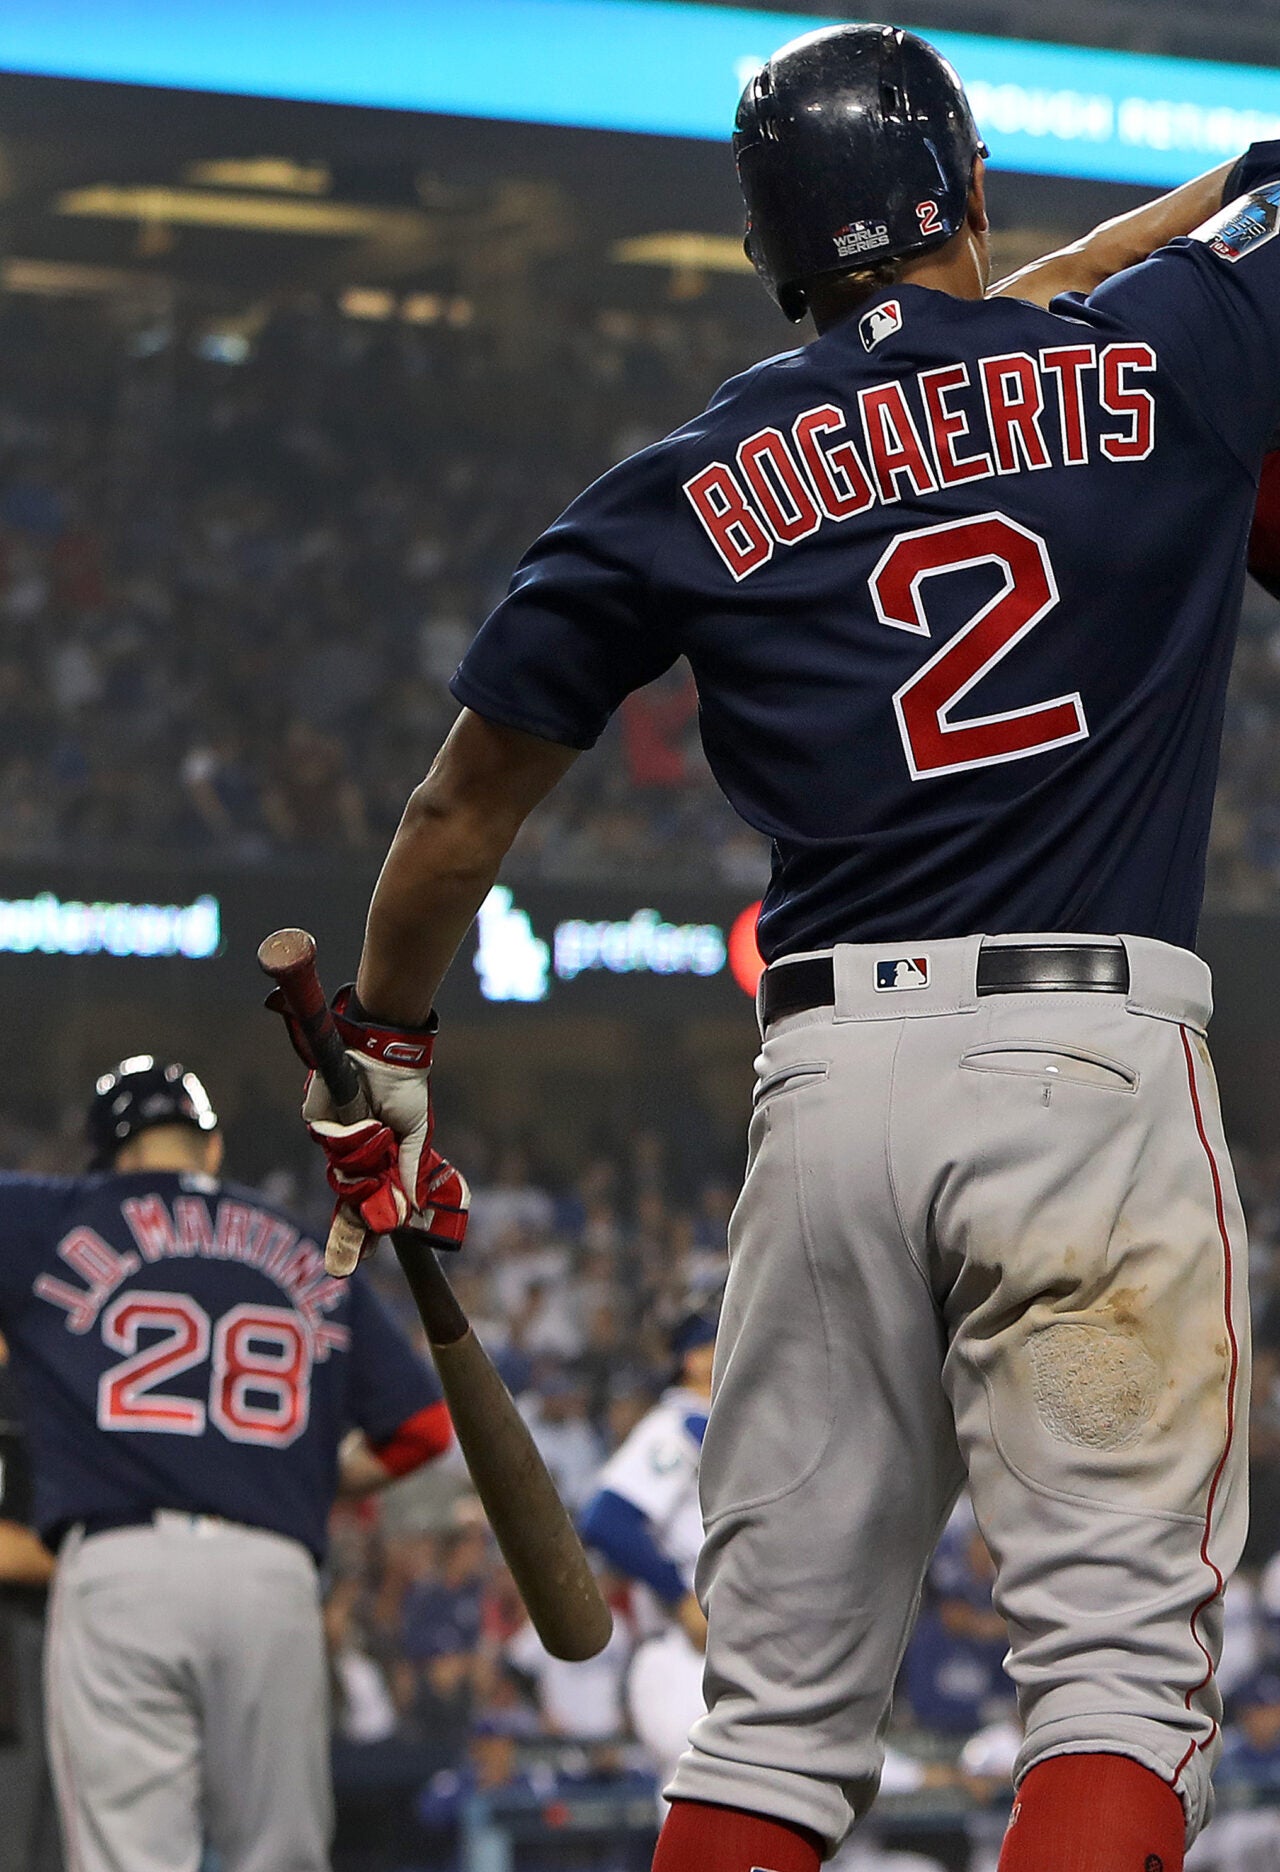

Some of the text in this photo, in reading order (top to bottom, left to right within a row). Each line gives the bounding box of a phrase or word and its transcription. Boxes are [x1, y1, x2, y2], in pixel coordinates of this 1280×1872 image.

[833, 225, 887, 247] WORLD
[837, 235, 890, 257] SERIES
[915, 200, 943, 236] 2
[682, 342, 1157, 582] BOGAERTS
[868, 511, 1089, 781] 2
[97, 1289, 313, 1450] 28
